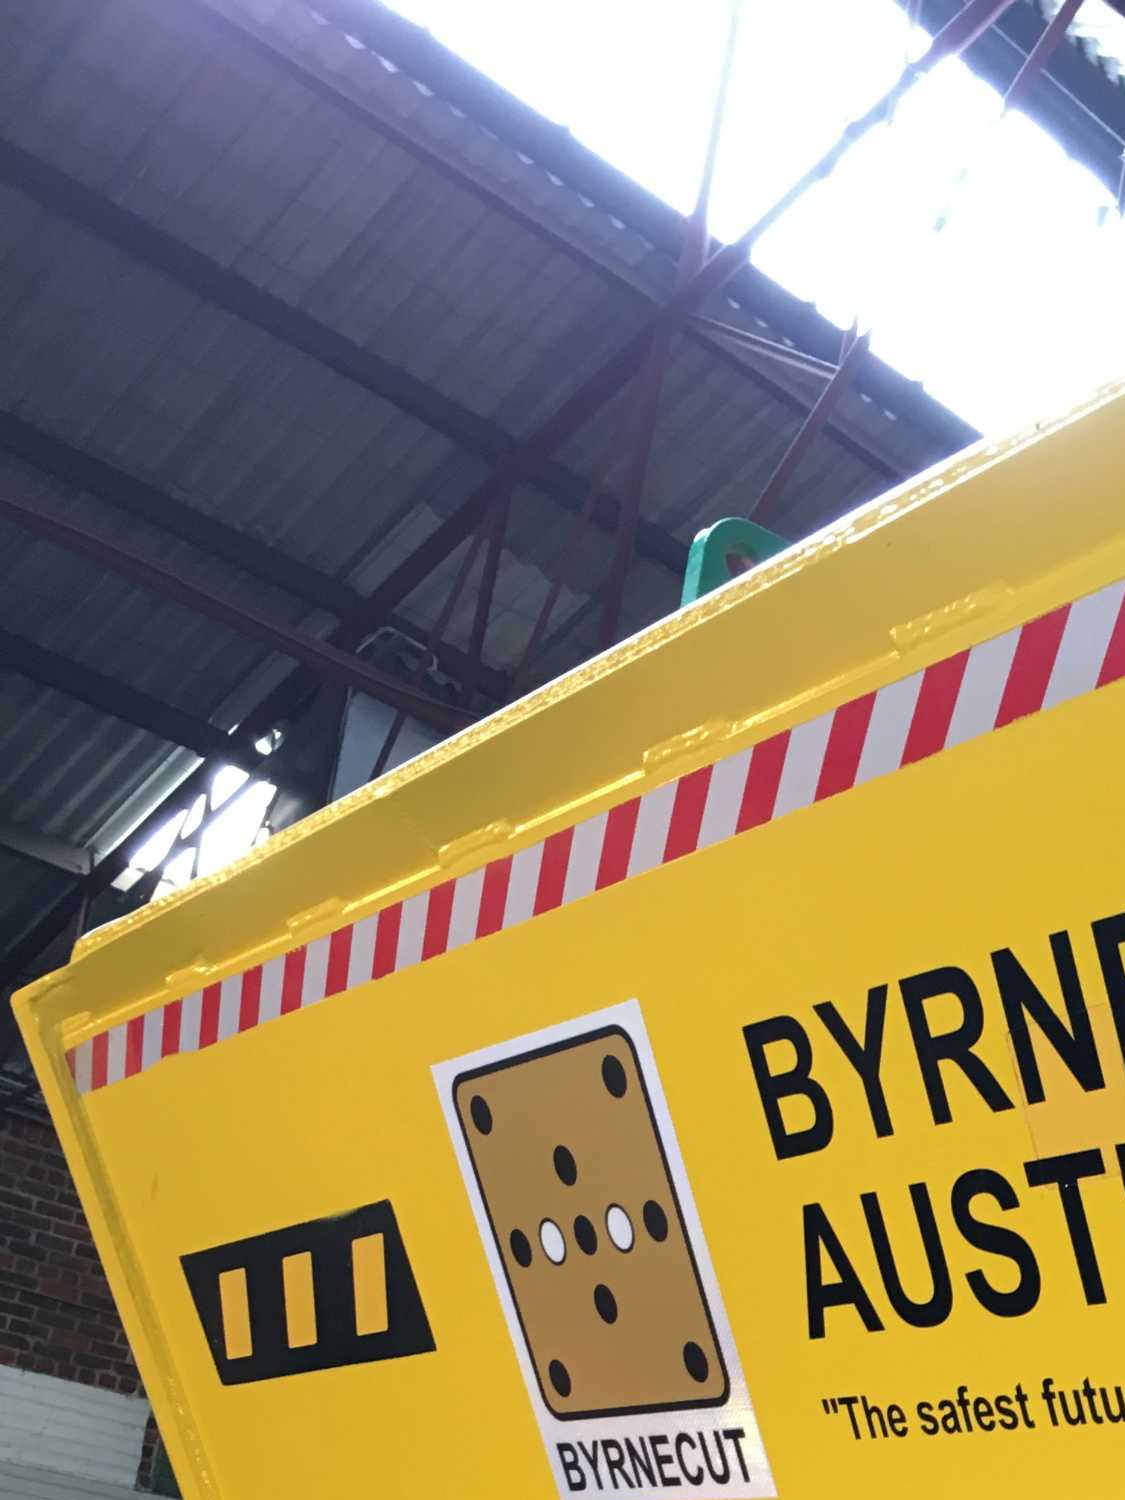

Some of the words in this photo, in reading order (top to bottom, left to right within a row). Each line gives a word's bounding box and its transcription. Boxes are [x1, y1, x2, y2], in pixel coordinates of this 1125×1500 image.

[821, 1395, 908, 1440] "The
[916, 1385, 1035, 1435] safest
[556, 1428, 750, 1492] BYRNECUT
